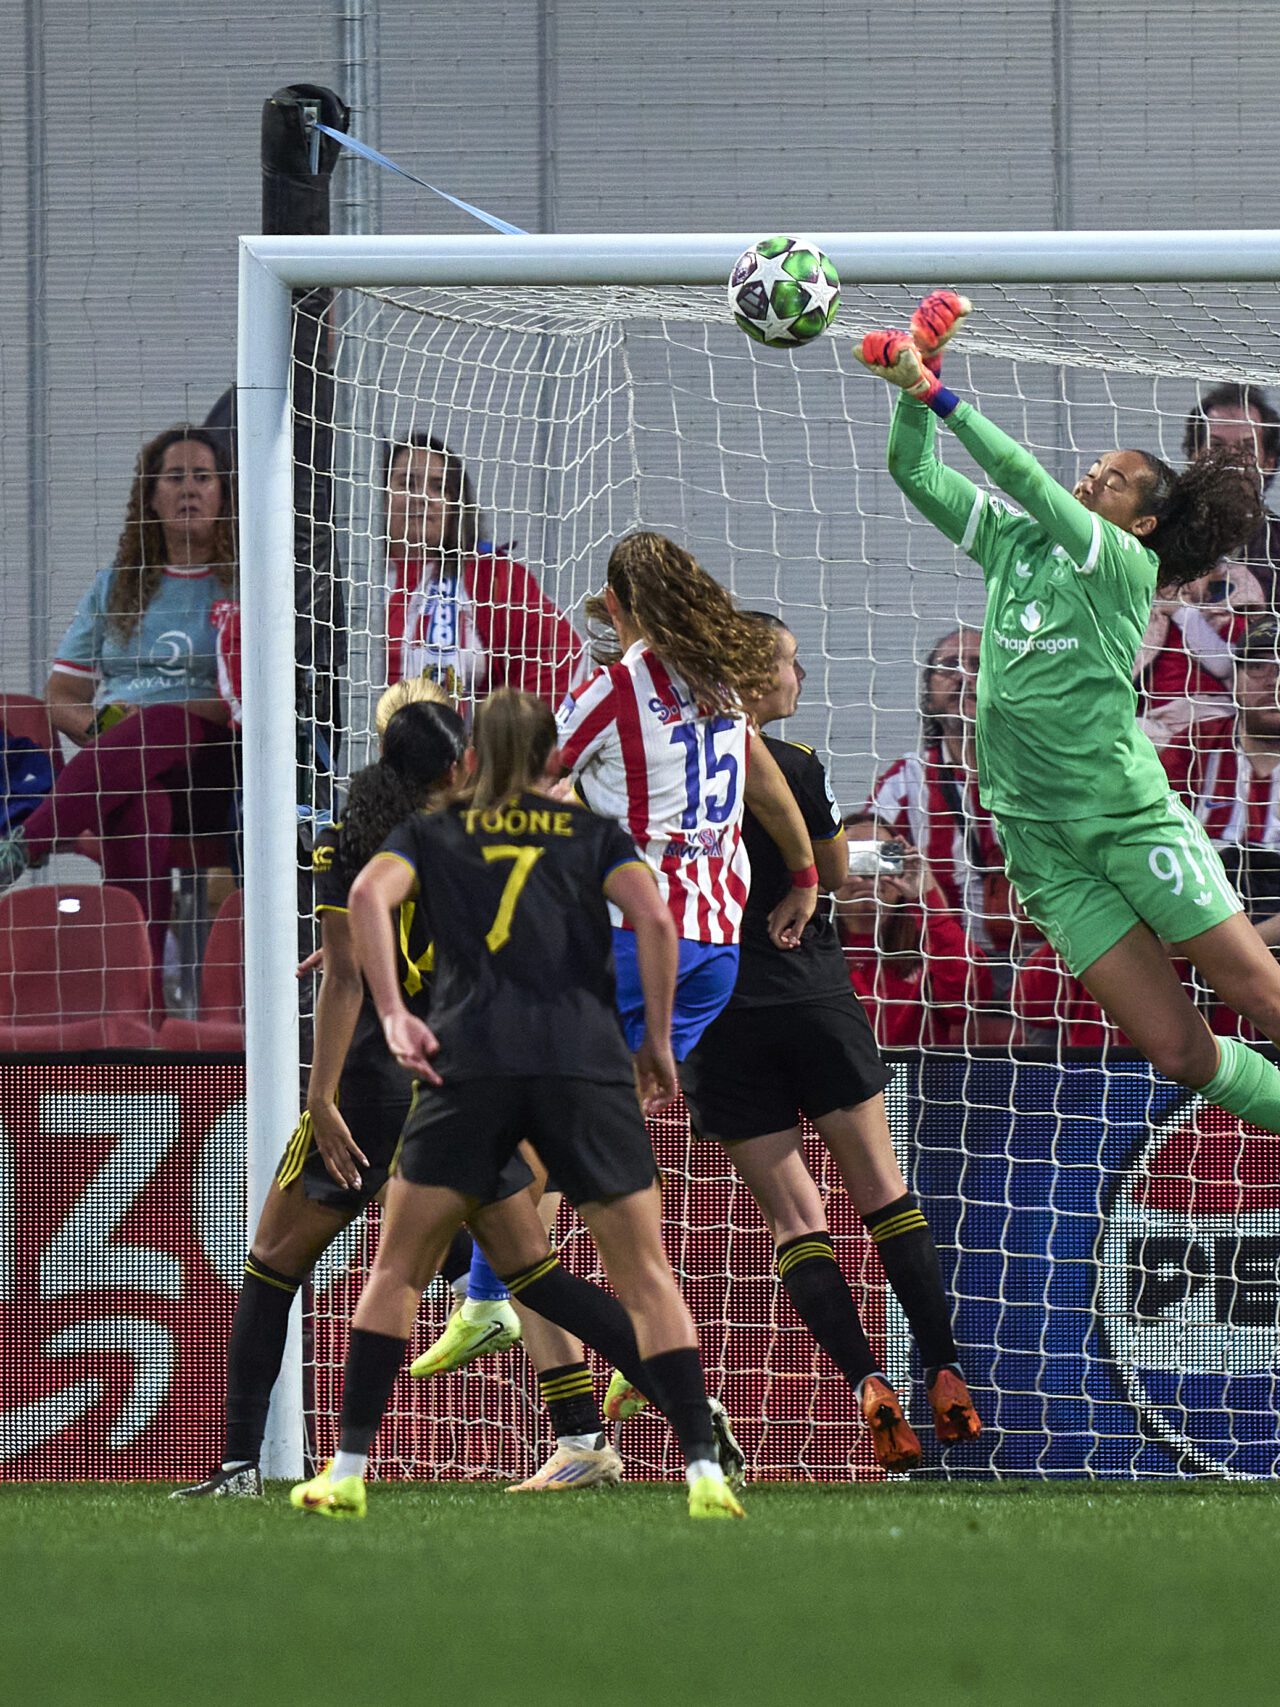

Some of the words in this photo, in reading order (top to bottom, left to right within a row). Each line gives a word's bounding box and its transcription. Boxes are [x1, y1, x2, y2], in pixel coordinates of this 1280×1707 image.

[993, 630, 1078, 655] napragon
[669, 716, 738, 829] 15
[459, 808, 574, 837] TOONE
[1148, 836, 1206, 896] 91
[481, 845, 545, 953] 7
